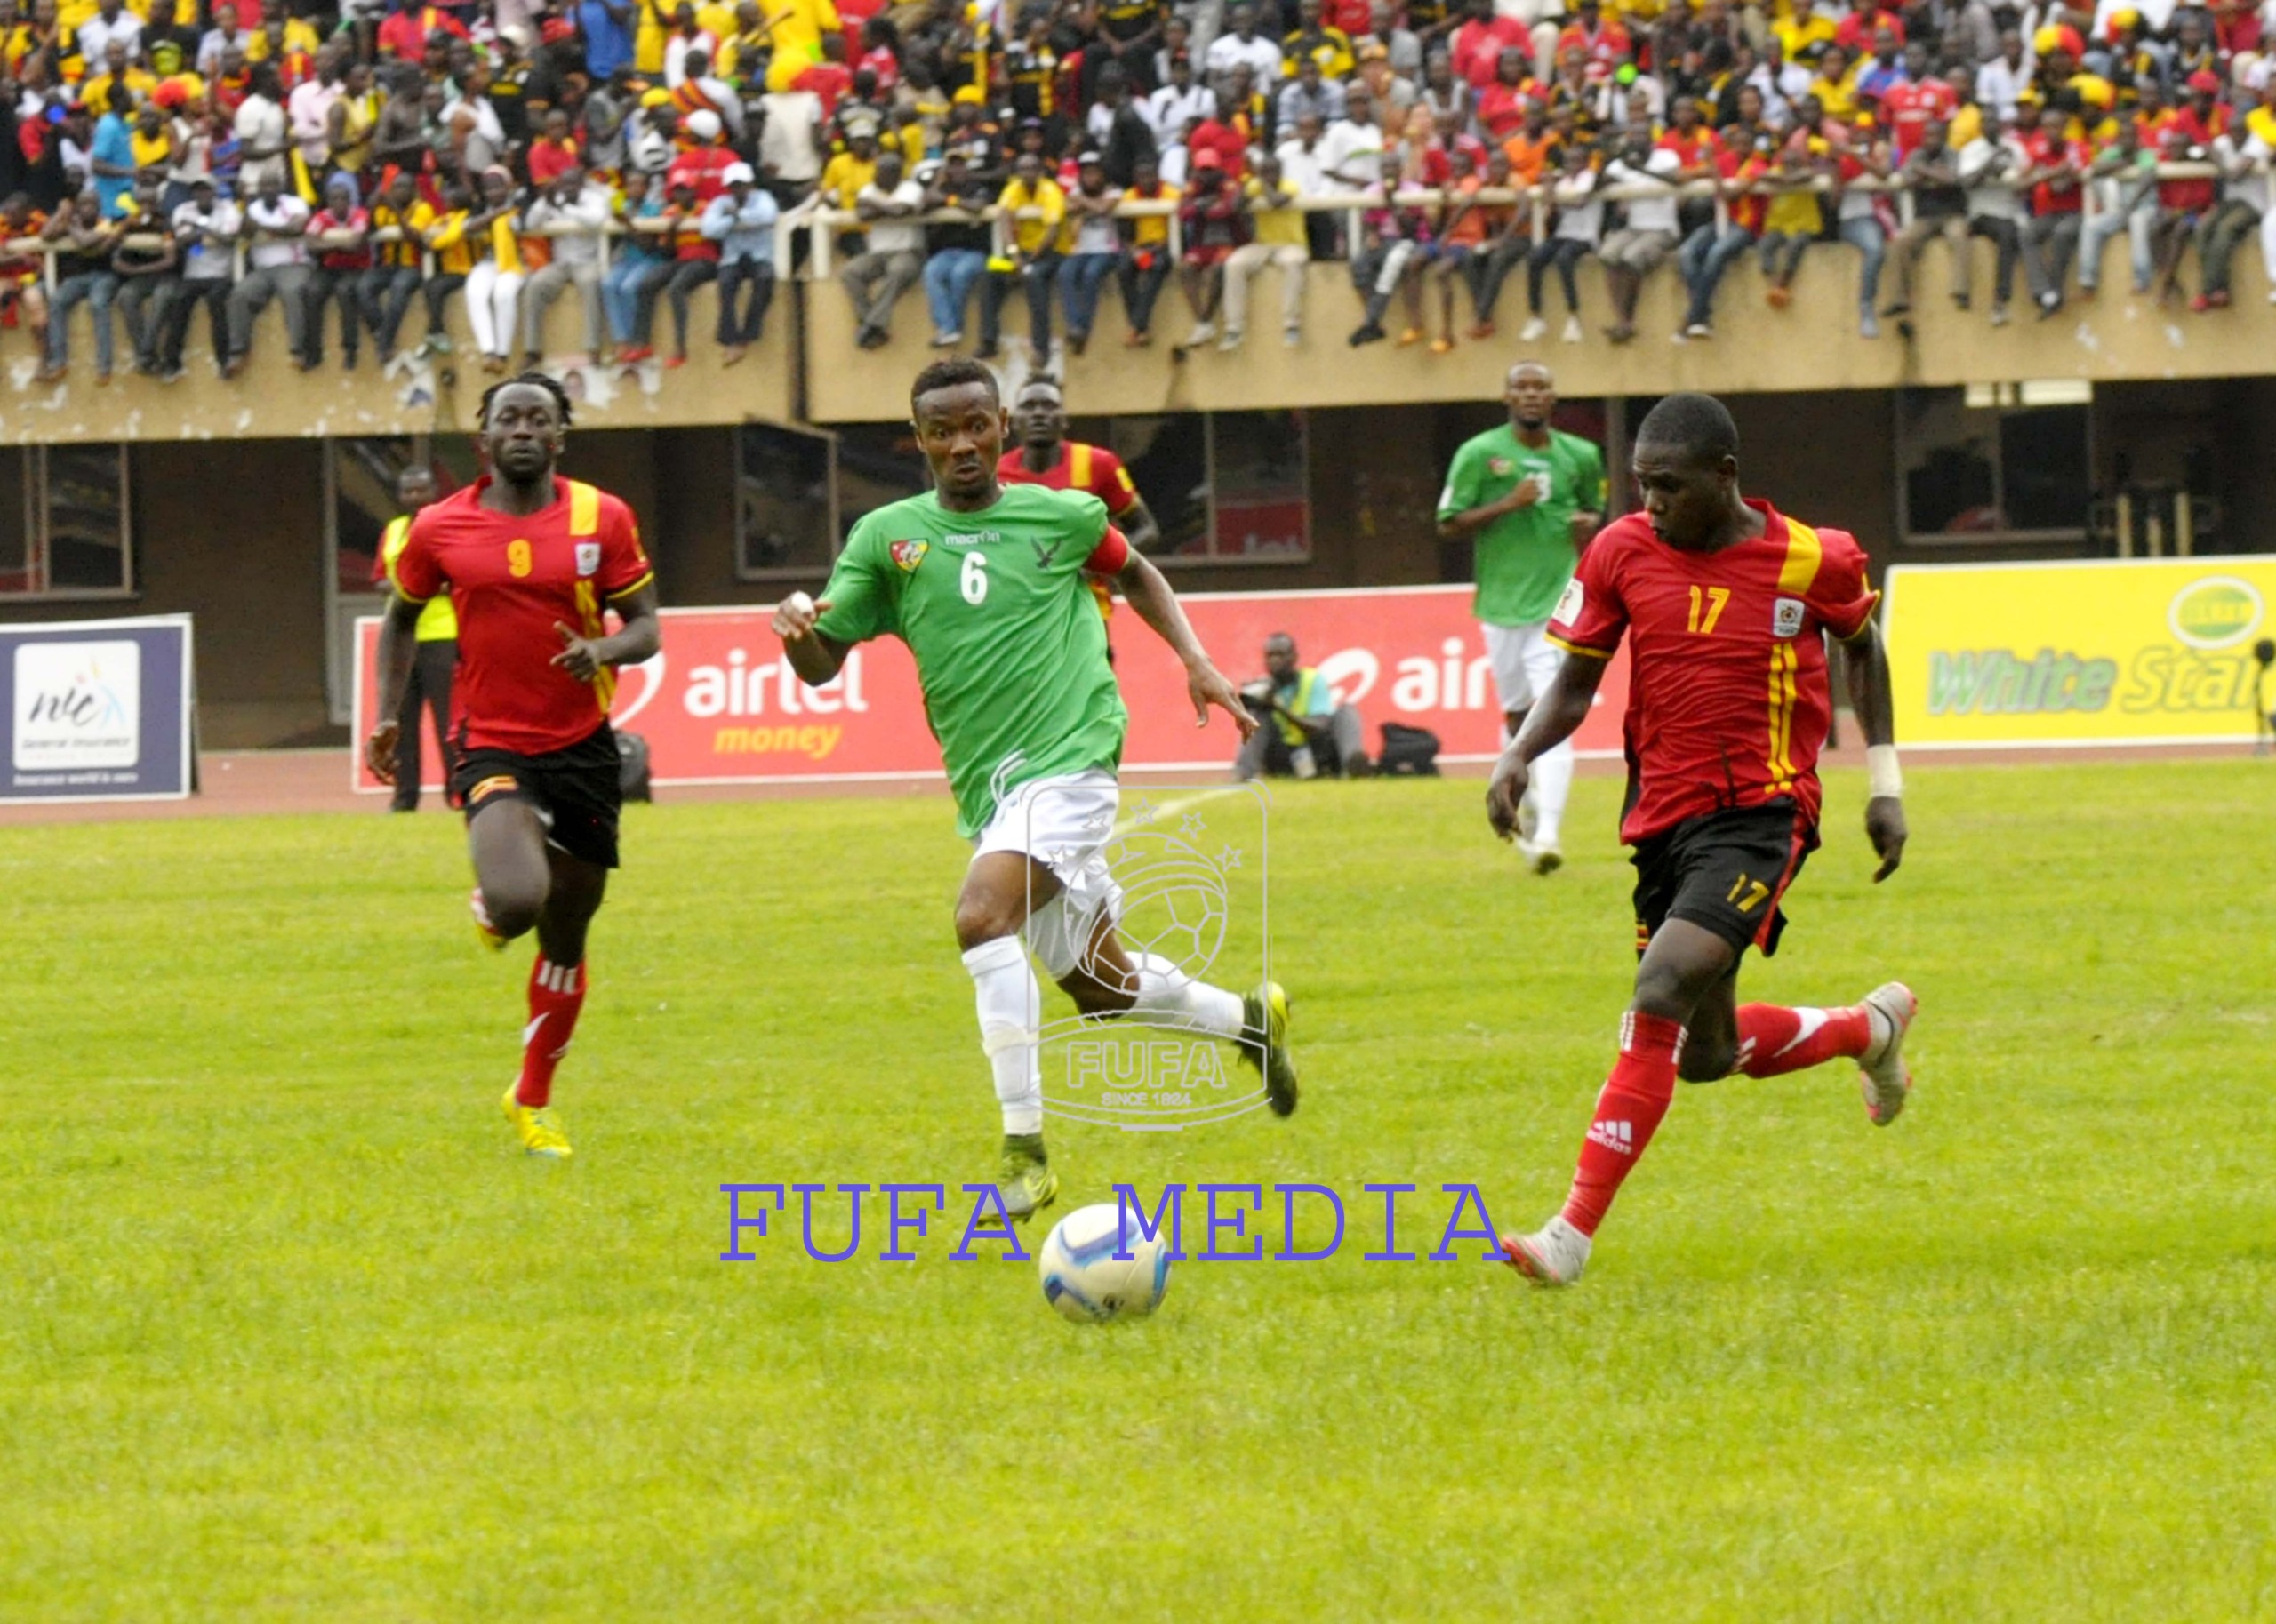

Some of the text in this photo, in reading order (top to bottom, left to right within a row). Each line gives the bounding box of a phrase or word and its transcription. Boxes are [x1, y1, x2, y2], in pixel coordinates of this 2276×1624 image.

[507, 539, 532, 577] 9
[960, 550, 988, 604] 6
[1687, 585, 1731, 634] 17
[684, 647, 869, 717] airtel
[1927, 648, 2118, 715] White
[714, 724, 841, 760] money
[1727, 873, 1770, 912] 17
[1586, 1129, 1632, 1155] adidas
